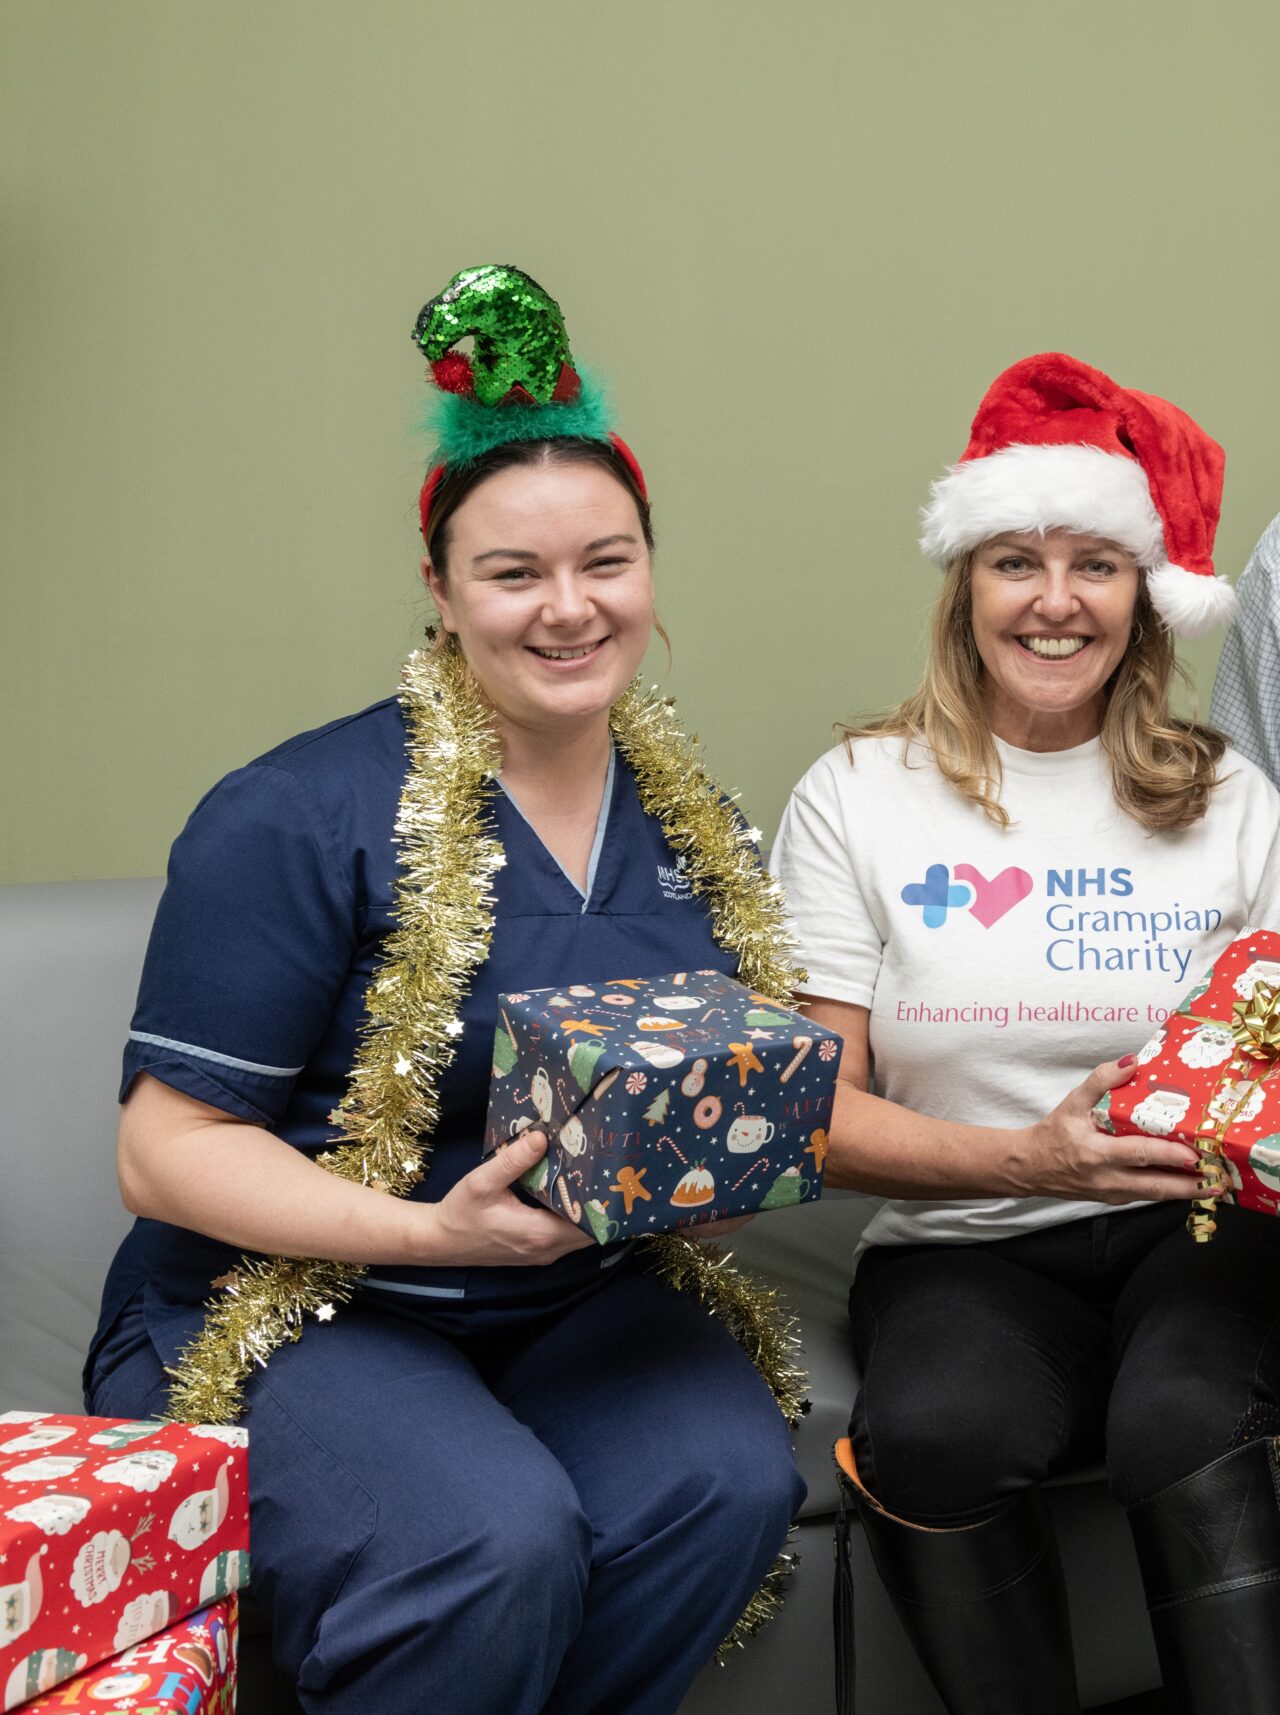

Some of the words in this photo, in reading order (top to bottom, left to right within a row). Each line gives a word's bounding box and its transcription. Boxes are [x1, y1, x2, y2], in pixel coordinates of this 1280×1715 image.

[1046, 867, 1134, 897] NHS
[1046, 903, 1222, 942] Grampian
[1046, 938, 1193, 984] Charity
[896, 1001, 1009, 1028] Enhancing
[1017, 1001, 1139, 1022] healthcare
[84, 1544, 97, 1601] CHRISTMAS
[96, 1551, 106, 1584] MERRY
